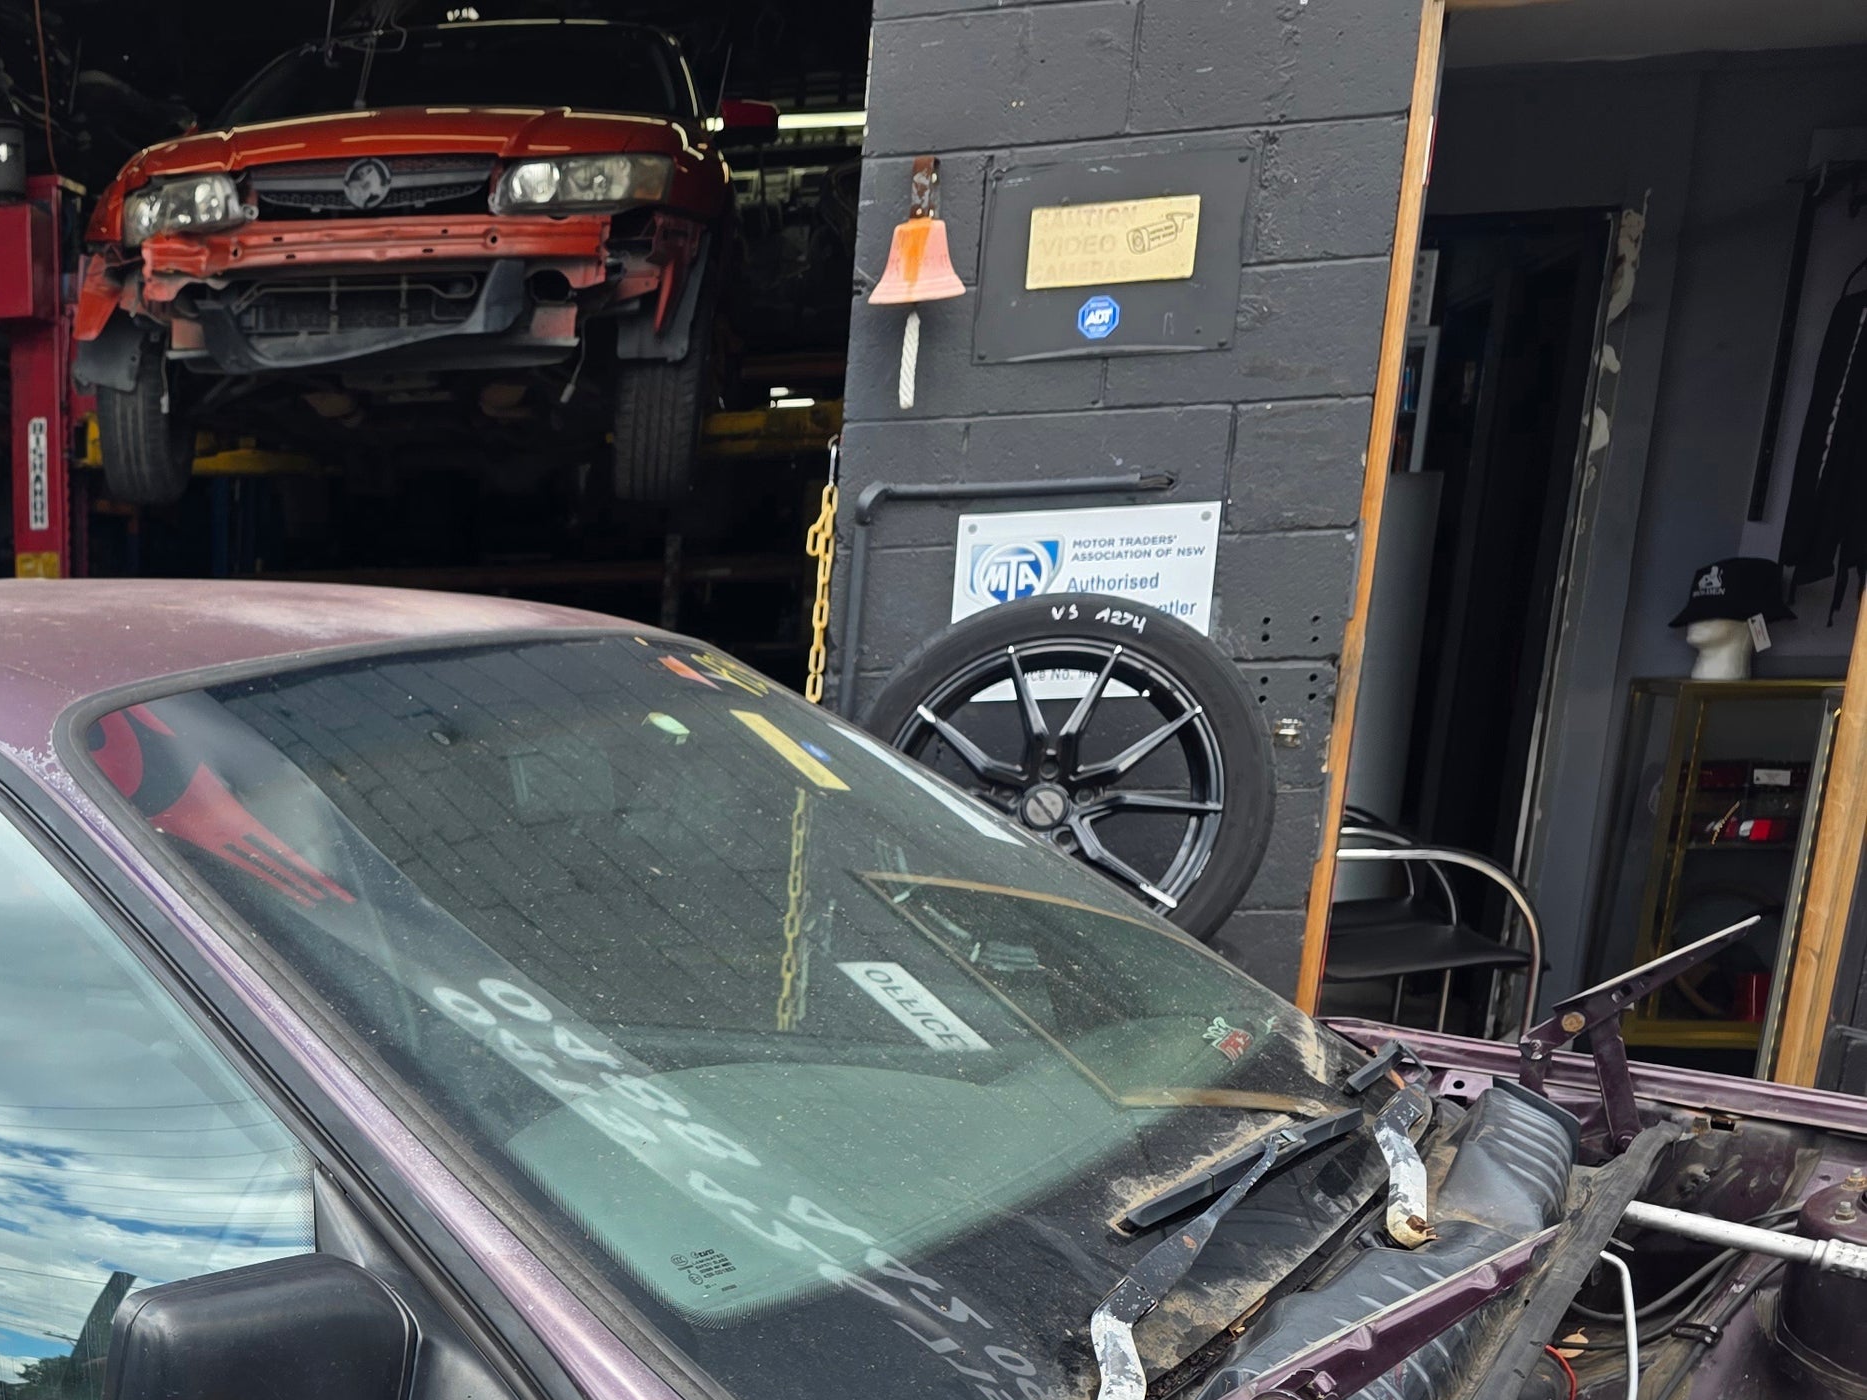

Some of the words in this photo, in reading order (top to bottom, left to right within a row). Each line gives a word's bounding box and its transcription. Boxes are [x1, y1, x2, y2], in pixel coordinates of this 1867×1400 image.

[1037, 233, 1117, 257] VIDEO
[1085, 307, 1113, 327] ADT
[1072, 538, 1115, 549] MOTOR
[1120, 535, 1177, 547] TRADERS'
[1071, 550, 1152, 562] ASSOCIATION
[1156, 549, 1172, 558] OF
[1177, 546, 1206, 557] NSW
[985, 553, 1041, 602] MTA
[1067, 573, 1159, 593] Authorised
[1051, 603, 1079, 620] VS
